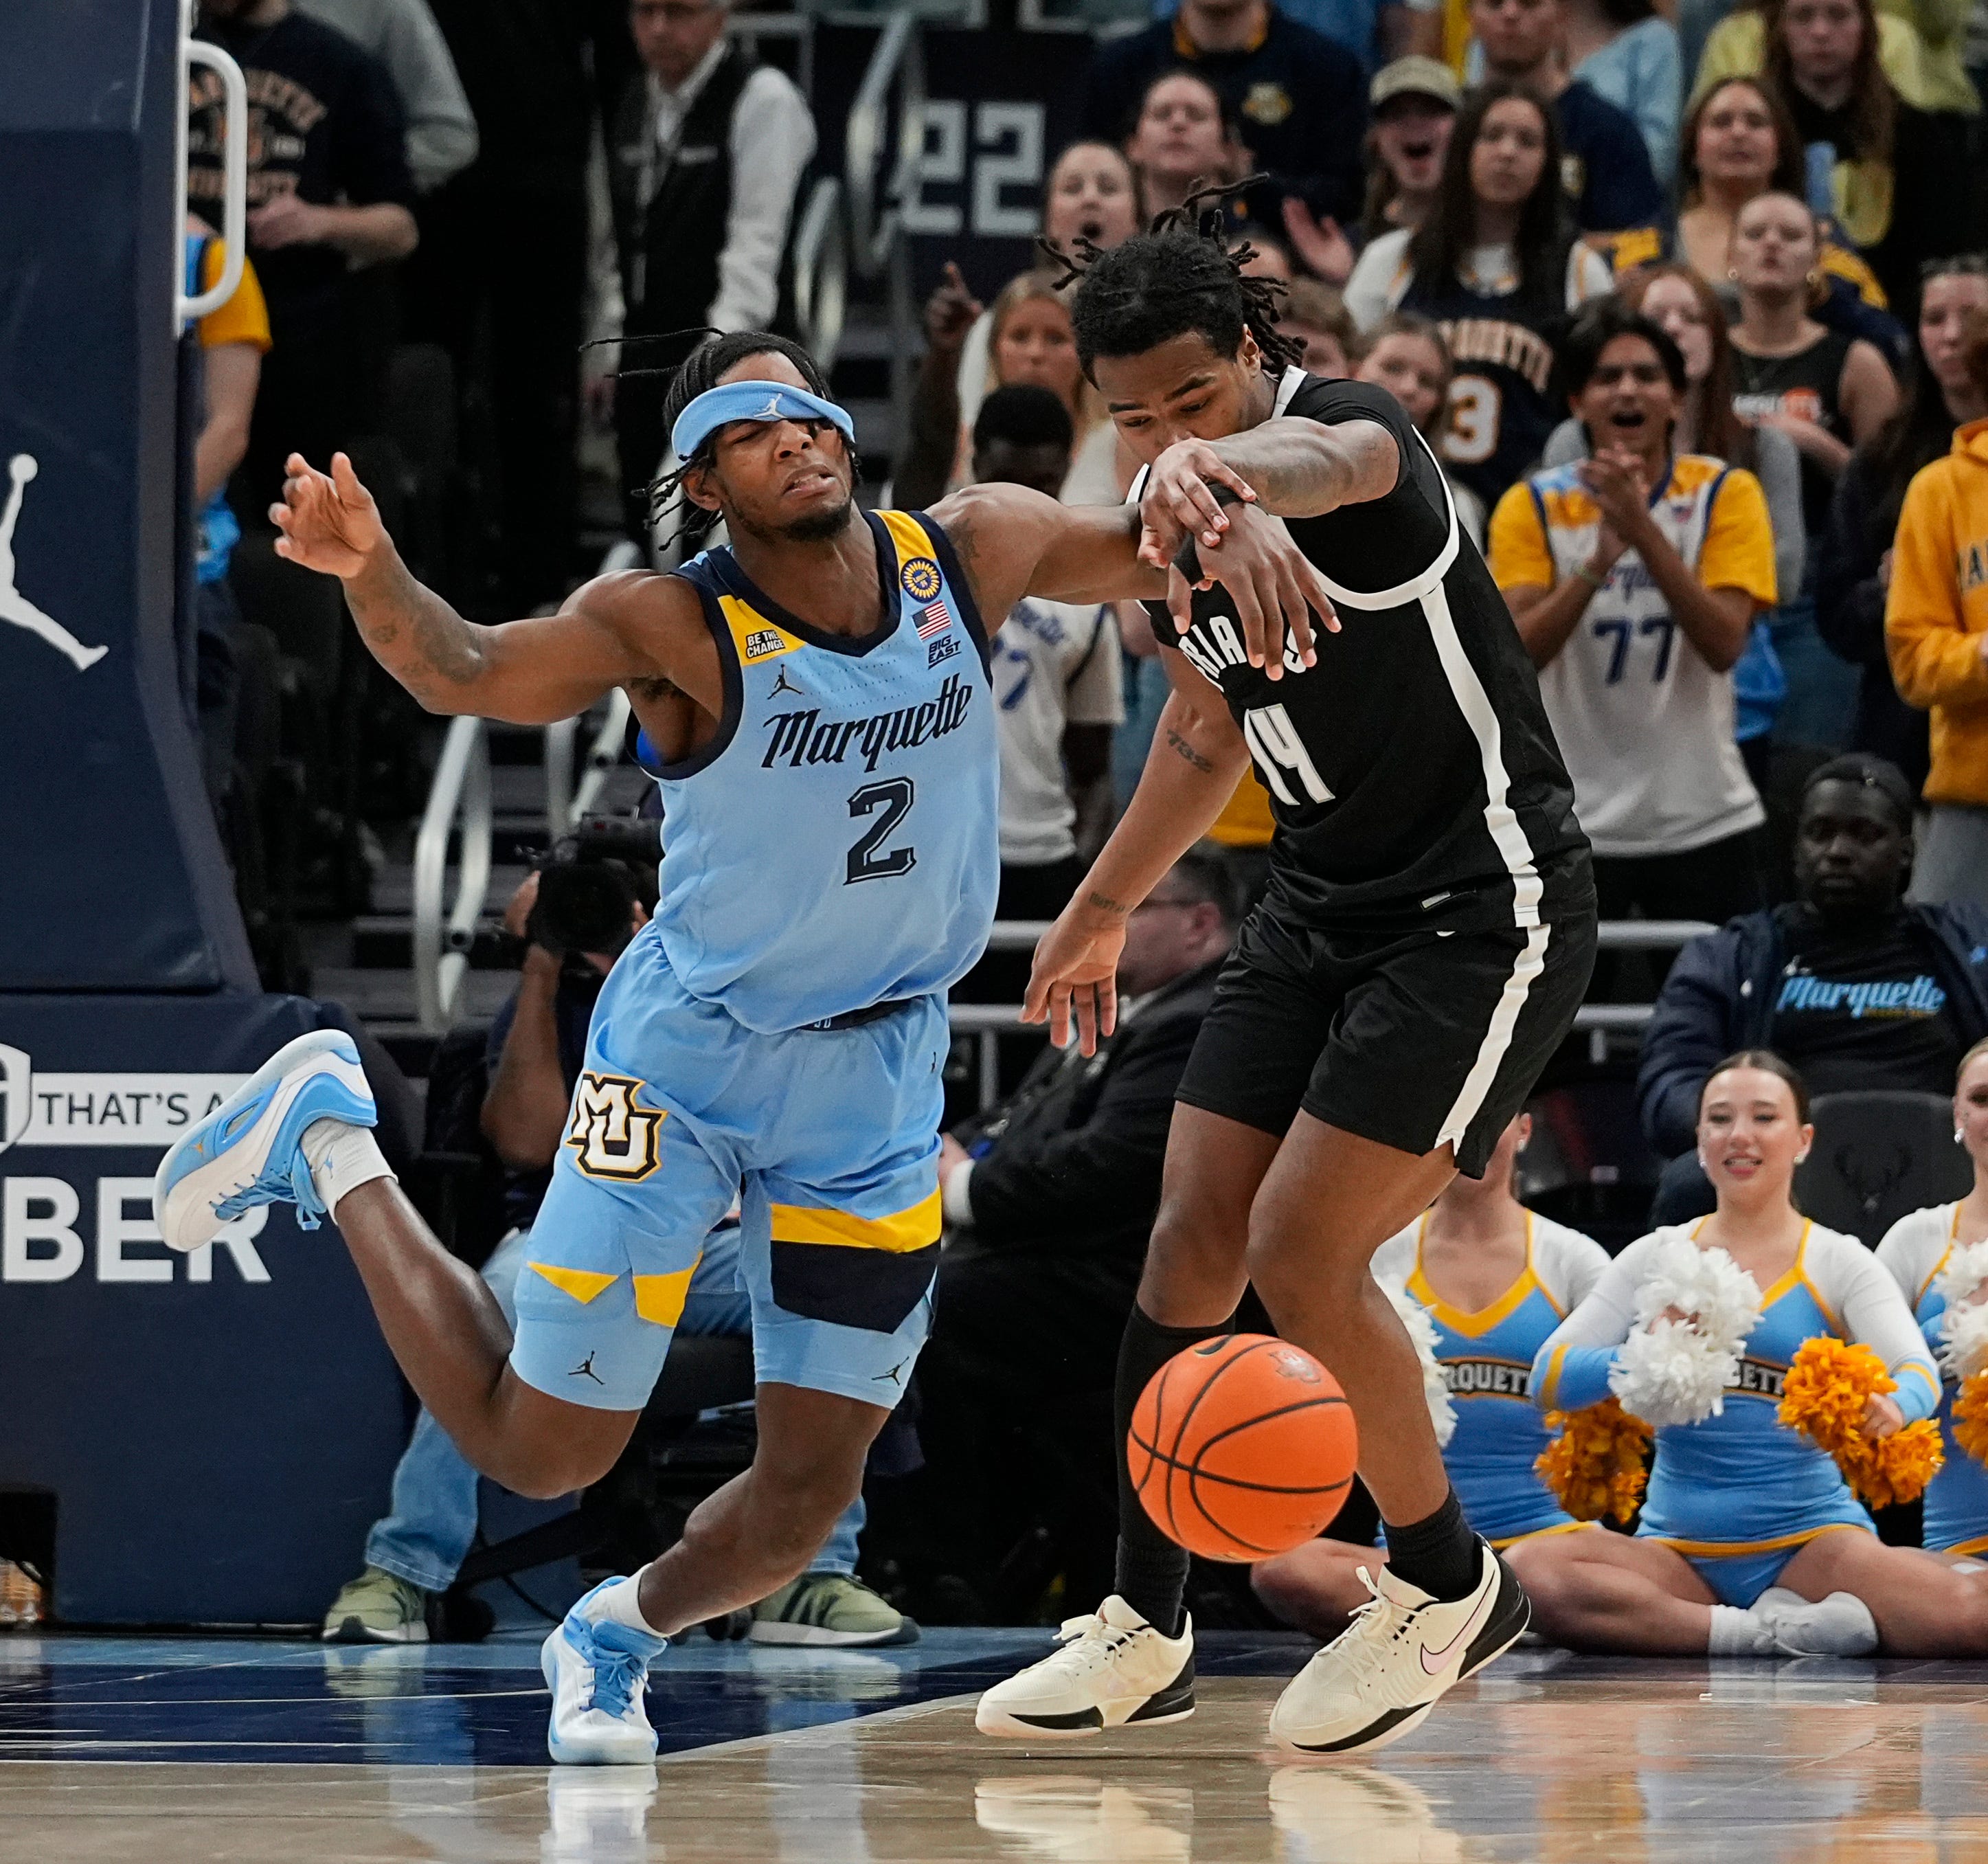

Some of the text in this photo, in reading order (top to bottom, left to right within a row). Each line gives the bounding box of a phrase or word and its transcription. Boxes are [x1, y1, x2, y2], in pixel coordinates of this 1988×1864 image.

[900, 100, 1045, 234] 22
[1443, 375, 1502, 463] 3
[747, 631, 778, 647] BE THE
[747, 639, 784, 658] CHANGE
[928, 640, 960, 664] EAST
[929, 634, 951, 653] BIG
[1594, 617, 1675, 684] 77
[761, 673, 973, 773] Marquette
[1244, 703, 1335, 805] 14
[844, 776, 916, 886] 2
[1775, 976, 1946, 1018] Marquette
[38, 1092, 190, 1125] THAT'S
[565, 1070, 668, 1183] MU
